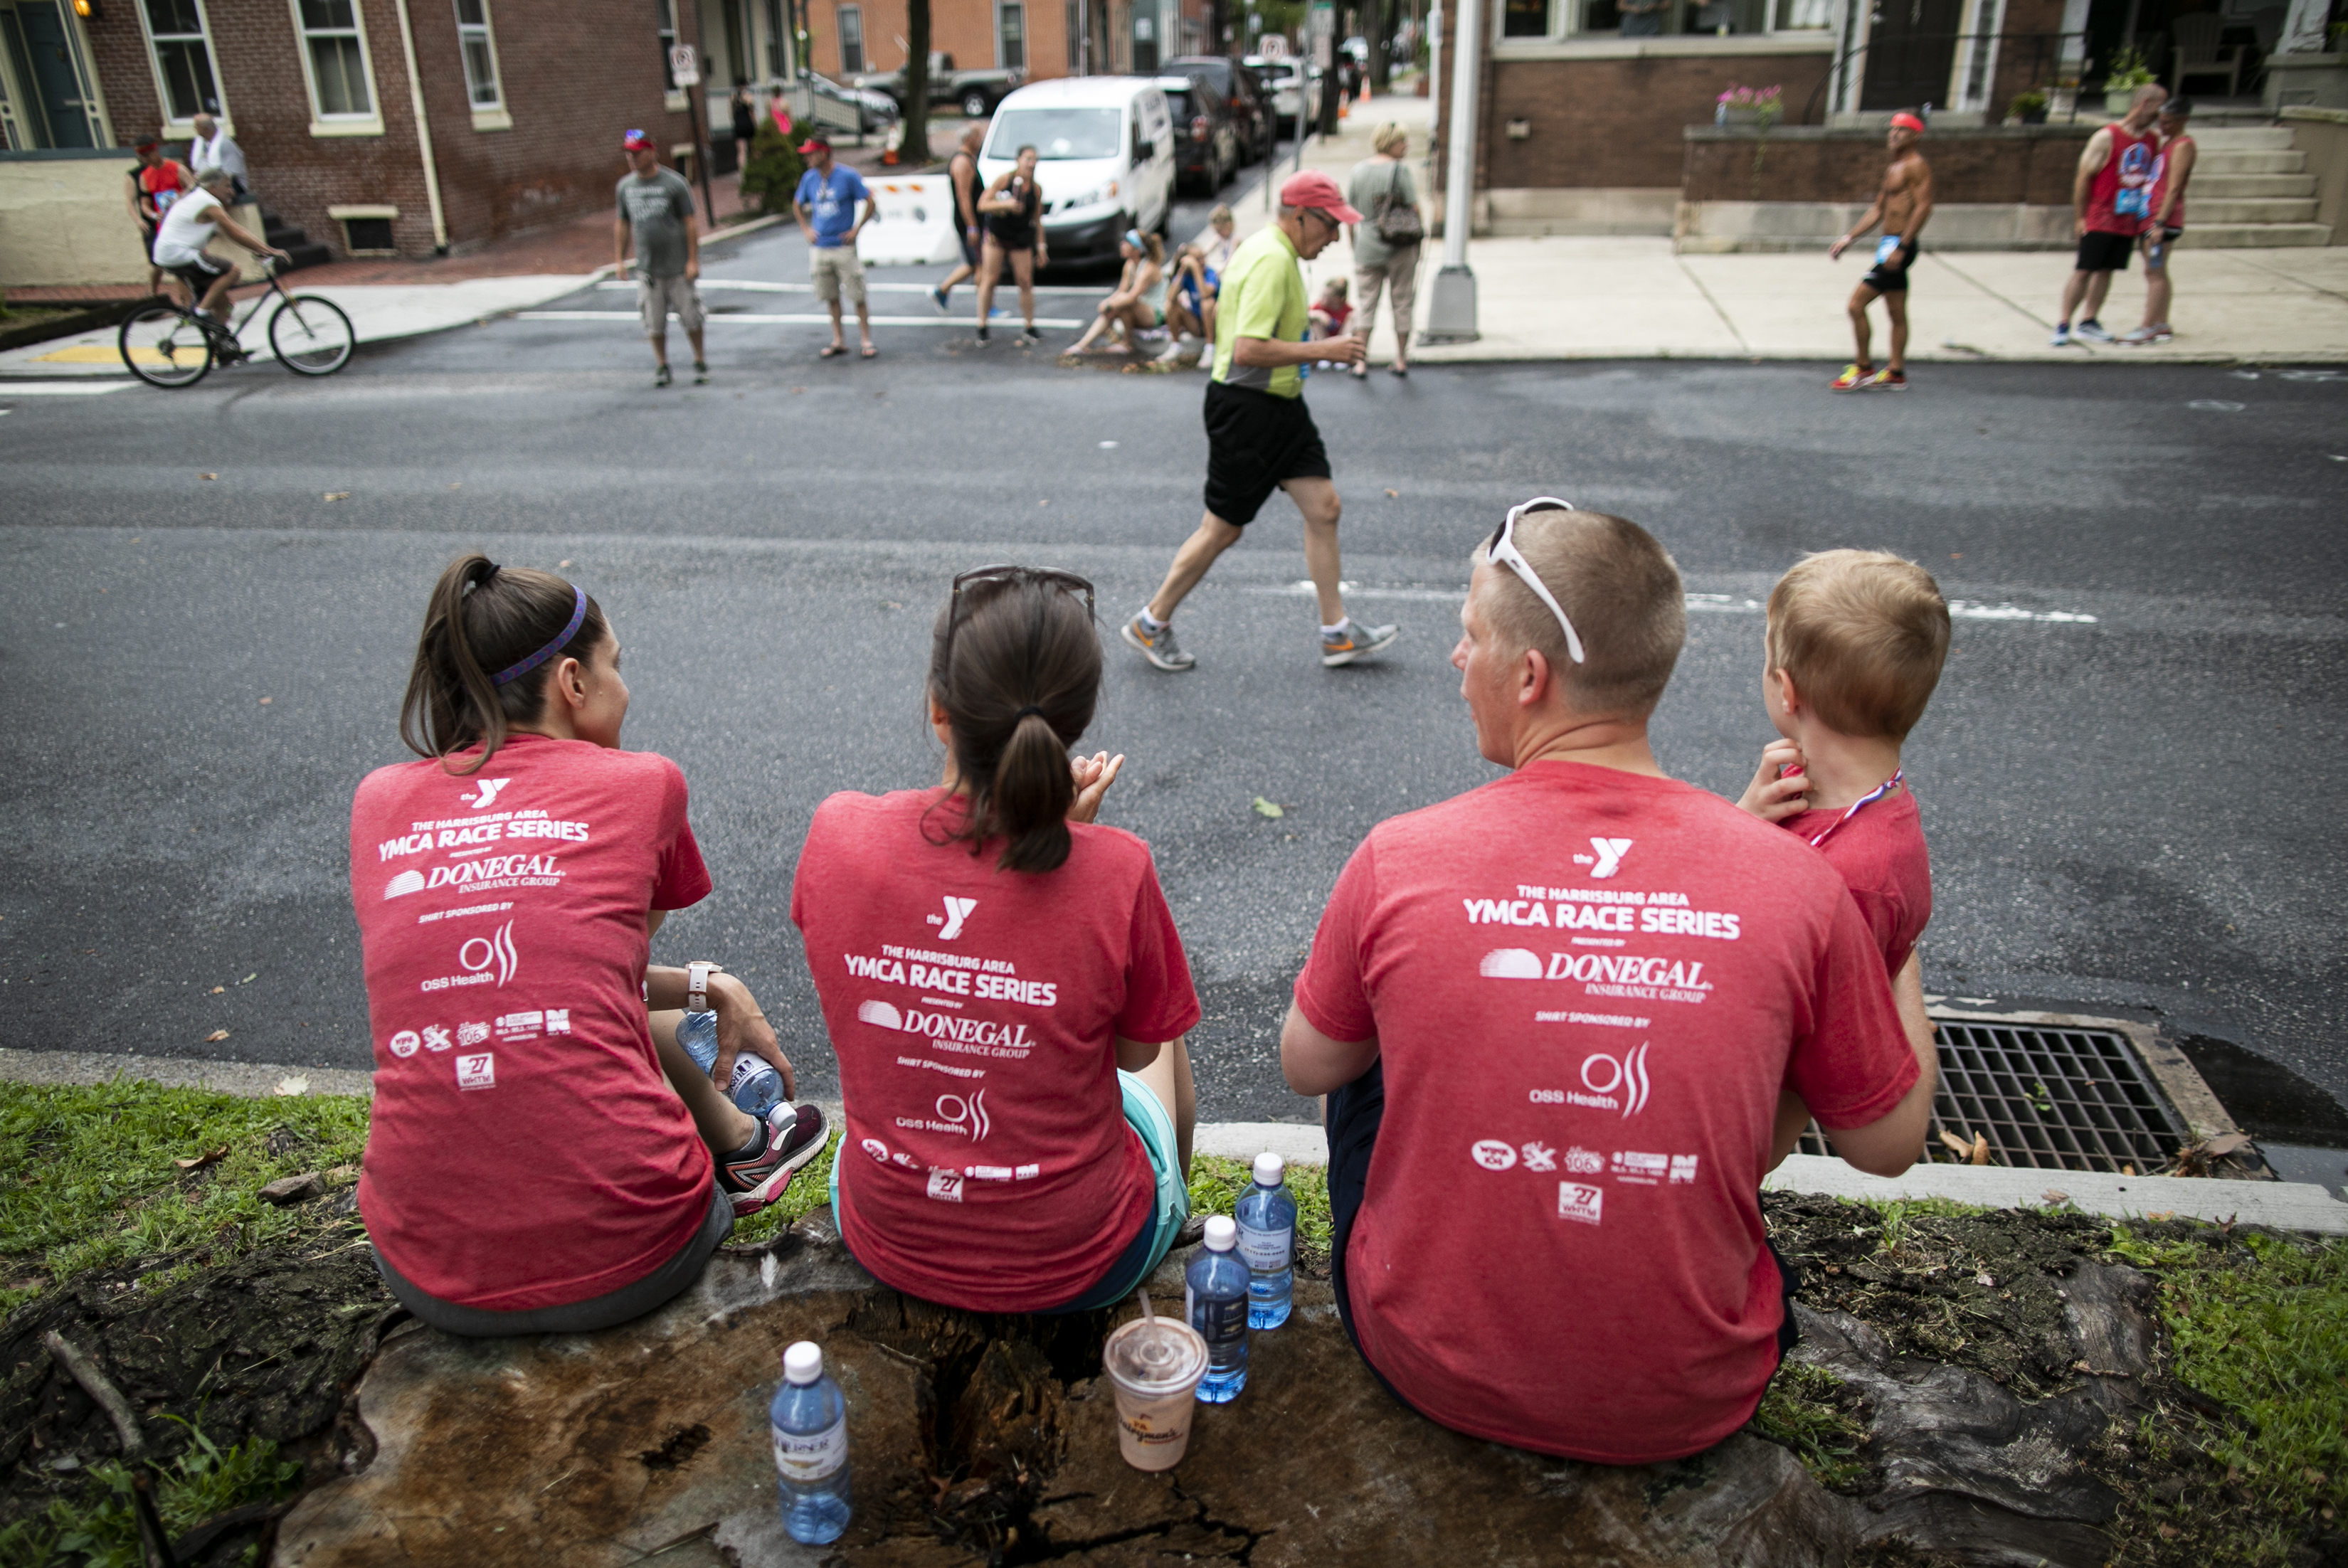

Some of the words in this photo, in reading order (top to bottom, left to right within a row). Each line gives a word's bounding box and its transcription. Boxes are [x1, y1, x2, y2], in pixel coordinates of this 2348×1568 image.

[411, 821, 434, 832] THE
[435, 812, 512, 830] HARRISBURG
[514, 810, 548, 819] AREA
[379, 833, 433, 862] YMCA
[438, 823, 502, 847] RACE
[506, 820, 589, 842] SERIES
[1572, 854, 1594, 865] the
[425, 854, 562, 889] DONEGAL
[458, 877, 519, 894] INSURANCE
[521, 877, 560, 886] GROUP
[1516, 884, 1546, 899] THE
[1548, 888, 1646, 906] HARRISBURG
[1647, 892, 1690, 906] AREA
[418, 911, 445, 923] SHIRT
[444, 903, 499, 918] SPONSORED
[499, 901, 514, 910] BY
[926, 913, 943, 926] the
[1463, 899, 1550, 927] YMCA
[1555, 904, 1635, 931] RACE
[1640, 907, 1741, 940] SERIES
[882, 944, 904, 958] THE
[905, 948, 980, 970] HARRISBURG
[981, 959, 1015, 975] AREA
[421, 977, 450, 991] OSS
[450, 971, 495, 986] Health
[844, 953, 906, 985] YMCA
[909, 963, 971, 995] RACE
[974, 974, 1057, 1007] SERIES
[1545, 952, 1710, 990] DONEGAL
[1585, 982, 1658, 1000] INSURANCE
[1659, 987, 1706, 1004] GROUP
[903, 1009, 1031, 1048] DONEGAL
[1534, 1010, 1567, 1022] SHIRT
[1567, 1012, 1634, 1027] SPONSORED
[1634, 1017, 1651, 1029] BY
[932, 1039, 990, 1056] INSURANCE
[991, 1047, 1030, 1059] GROUP
[468, 1056, 490, 1074] 27
[897, 1056, 922, 1068] SHIRT
[922, 1060, 971, 1079] SPONSORED
[972, 1069, 986, 1079] BY
[1529, 1089, 1565, 1103] OSS
[1566, 1091, 1619, 1111] Health
[896, 1117, 924, 1130] OSS
[926, 1120, 968, 1136] Health
[941, 1175, 961, 1193] 27
[1573, 1186, 1597, 1205] 27
